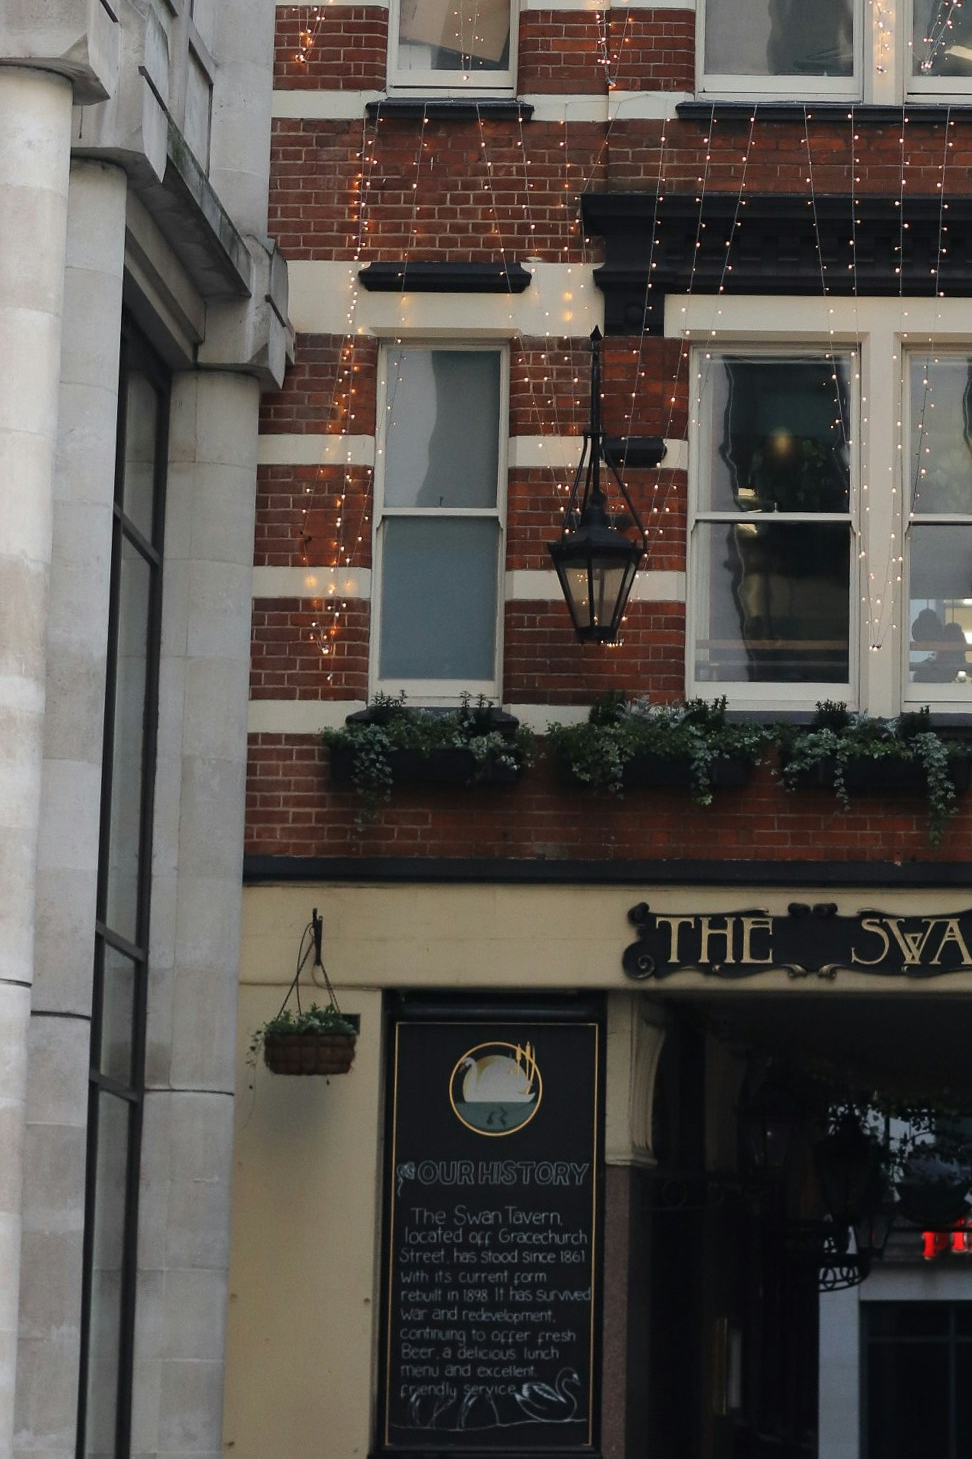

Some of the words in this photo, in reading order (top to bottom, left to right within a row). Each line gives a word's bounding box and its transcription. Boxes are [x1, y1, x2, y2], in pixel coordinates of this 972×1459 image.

[655, 916, 774, 965] THE
[418, 1160, 475, 1185] OUR
[479, 1160, 590, 1186] HISTORY
[410, 1207, 446, 1225] The
[454, 1204, 502, 1225] Swan
[405, 1227, 462, 1244] located
[469, 1231, 493, 1247] off
[499, 1228, 588, 1245] Gracechurch
[453, 1246, 477, 1263] has
[522, 1249, 556, 1263] since
[560, 1250, 585, 1263] 1861
[435, 1271, 452, 1284] its
[458, 1269, 508, 1284] current
[514, 1271, 547, 1286] form
[400, 1288, 442, 1302] rebuilt
[447, 1289, 459, 1301] in
[495, 1287, 504, 1301] It
[509, 1286, 532, 1301] has
[536, 1287, 592, 1302] survived
[432, 1306, 458, 1321] and
[400, 1327, 466, 1346] continuing
[472, 1329, 486, 1342] to
[491, 1330, 531, 1343] offer
[537, 1330, 576, 1343] fresh
[442, 1347, 452, 1359] a
[457, 1345, 516, 1360] delicious
[524, 1346, 560, 1360] lunch
[400, 1365, 439, 1378] menu
[445, 1364, 471, 1377] and
[400, 1382, 457, 1399] friendly
